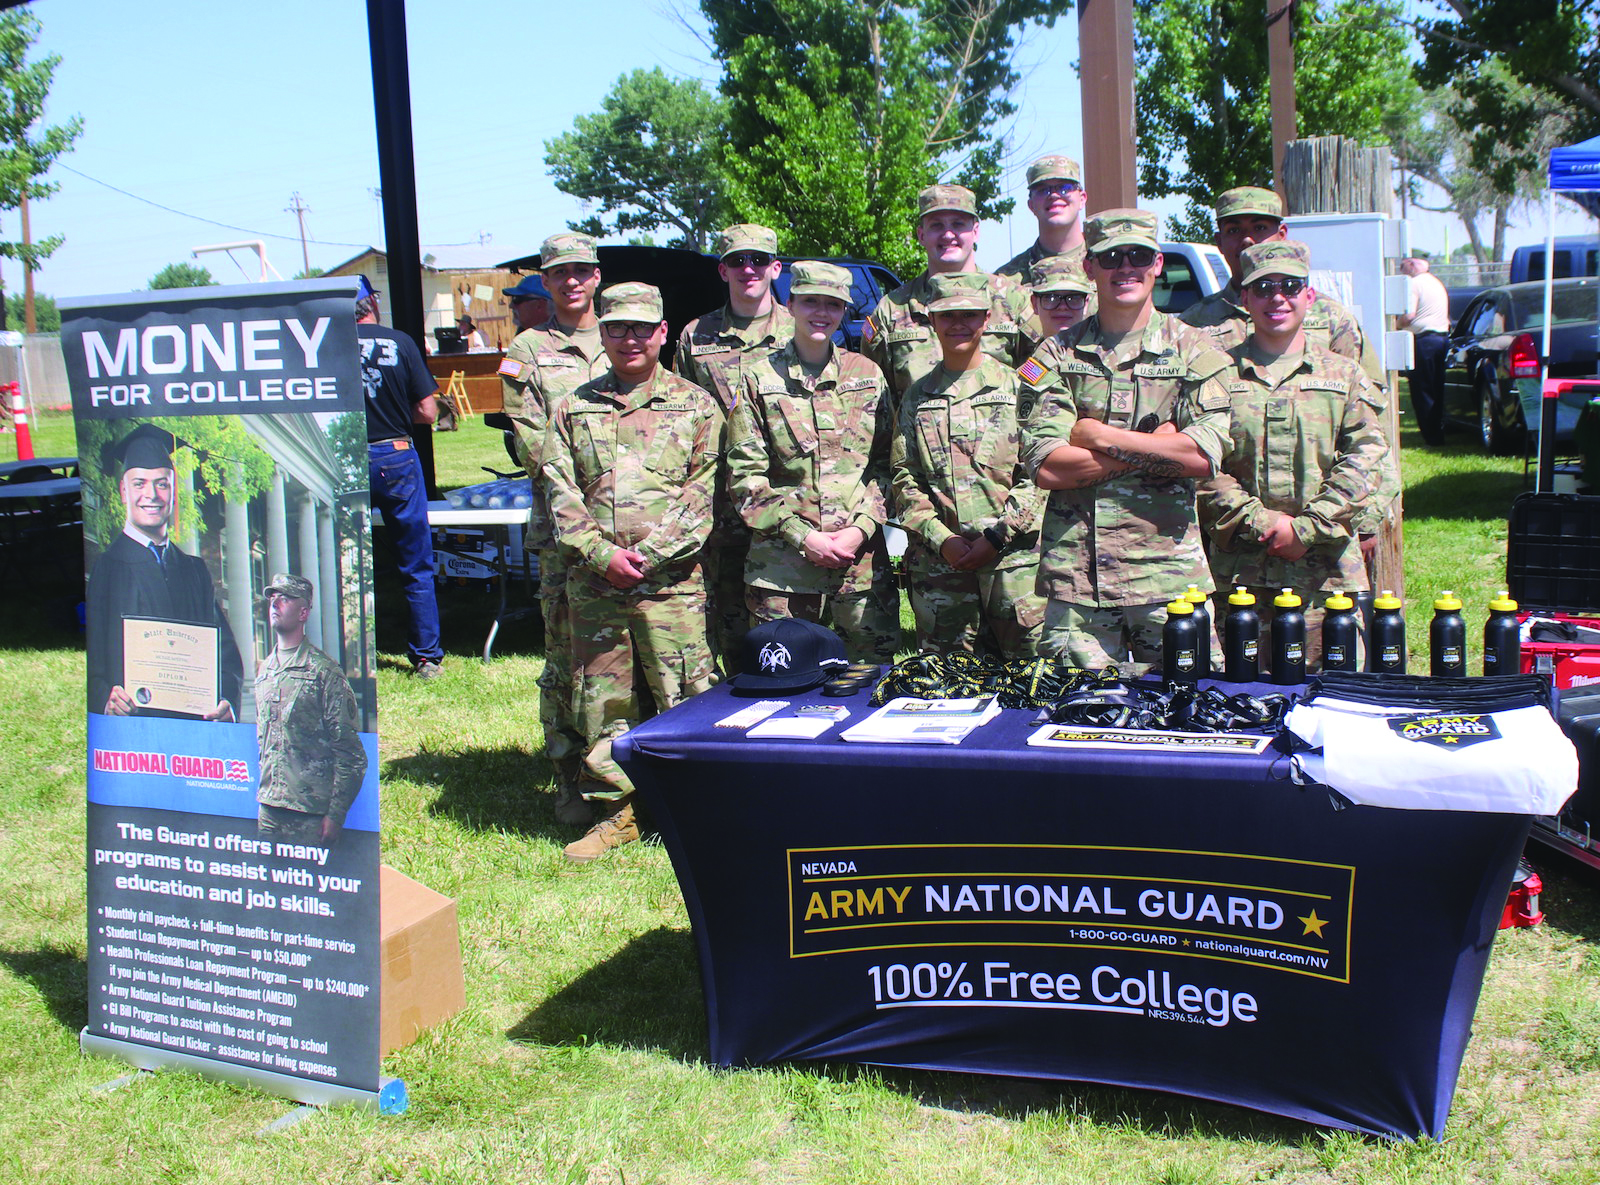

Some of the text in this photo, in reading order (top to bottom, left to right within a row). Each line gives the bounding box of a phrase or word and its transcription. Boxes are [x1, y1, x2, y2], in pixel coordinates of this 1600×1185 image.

[81, 316, 331, 379] MONEY
[854, 379, 874, 388] ARMY
[1067, 363, 1104, 374] WENGER
[1140, 367, 1181, 375] U.S. ARMY
[90, 377, 338, 407] FOR COLLEGE
[990, 394, 1012, 403] ARMY
[1323, 381, 1346, 390] ARMY
[448, 559, 476, 570] Corona
[144, 628, 199, 644] State University
[158, 672, 189, 681] DIPLOMA
[1102, 734, 1179, 744] NATIONAL
[1403, 716, 1480, 732] ARMY
[1404, 727, 1490, 739] GUARD
[94, 748, 226, 781] NATIONAL GUARD
[186, 779, 249, 792] NATIONALGUARD.com
[116, 822, 330, 866] The Guard offers many
[94, 848, 362, 894] programs to assist with your
[801, 861, 858, 876] NEVADA
[115, 874, 336, 917] education and job skills.
[804, 884, 1285, 931] ARMY NATIONAL GUARD
[104, 906, 356, 954] Monthly drill paycheck + full-time benefits for part-time service
[105, 925, 138, 941] Student
[138, 929, 157, 944] Loan
[157, 932, 200, 950] Repayment
[201, 939, 237, 957] Program
[251, 949, 262, 962] up
[263, 950, 273, 962] to
[1069, 928, 1330, 969] 1-800-GO-GUARD nationalguard.com/NV
[107, 944, 134, 960] Health
[134, 947, 185, 968] Professionals
[185, 955, 204, 971] Loan
[205, 959, 250, 979] Repayment
[251, 966, 288, 985] Program
[302, 977, 314, 991] up
[315, 977, 324, 991] to
[109, 964, 297, 1008] if you join the Army Medical Department (AMEDD)
[867, 961, 1259, 1028] 100% Free College
[108, 983, 292, 1027] Army National Guard Tuition Assistance Program
[1148, 1008, 1206, 1026] NRS396.544
[109, 1002, 328, 1055] GI Bill Programs to assist with the cost of going to school
[109, 1021, 130, 1039] Army
[130, 1025, 161, 1043] National
[162, 1032, 185, 1048] Guard
[186, 1035, 211, 1053] Kicker
[217, 1043, 260, 1062] assistance
[262, 1050, 274, 1065] for
[275, 1053, 297, 1072] living
[299, 1060, 338, 1078] expenses
